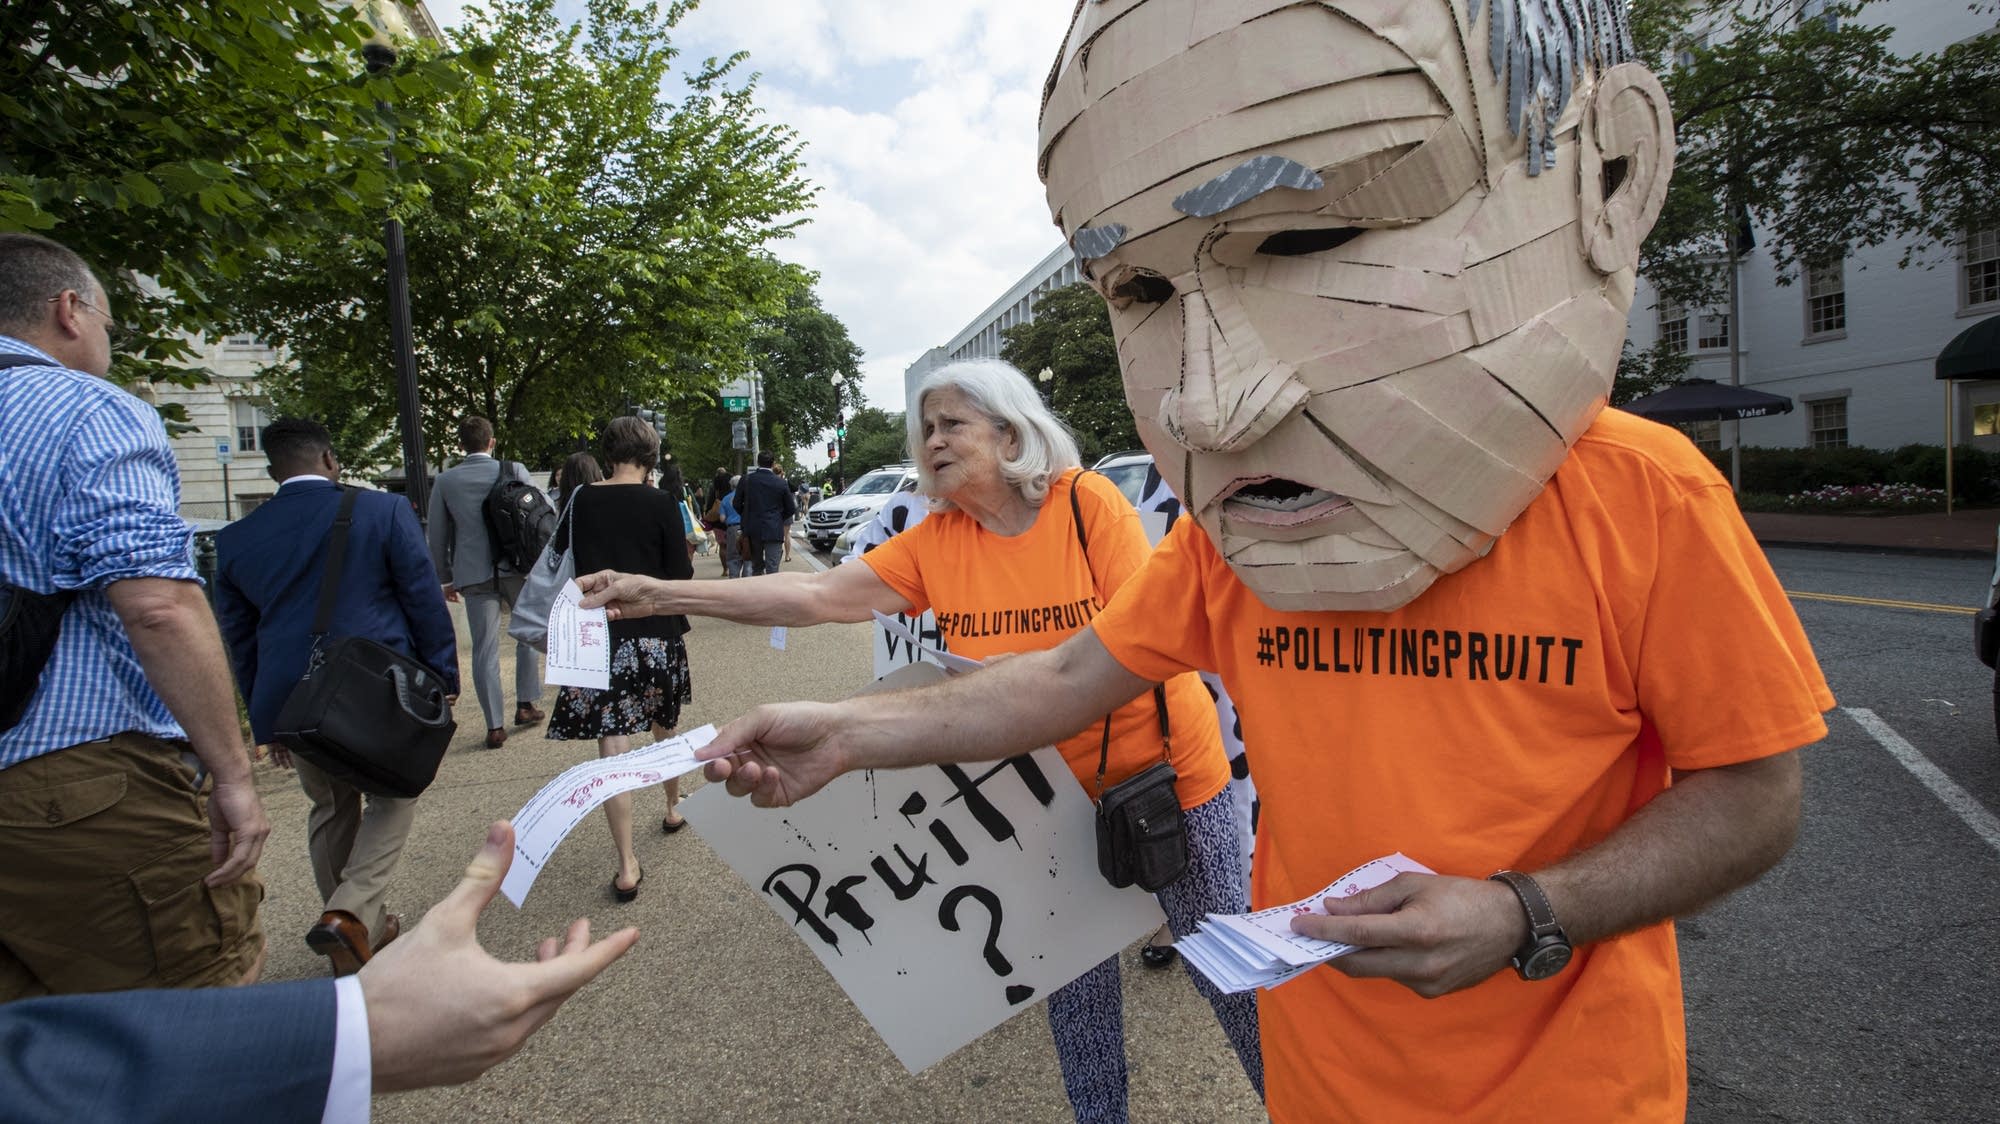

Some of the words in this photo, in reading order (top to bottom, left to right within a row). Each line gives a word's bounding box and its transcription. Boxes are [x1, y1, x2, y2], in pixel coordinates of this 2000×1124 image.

[1737, 408, 1766, 418] Valet
[1257, 626, 1583, 686] #POLLUTINGPRUITT
[938, 884, 1035, 1006] ?
